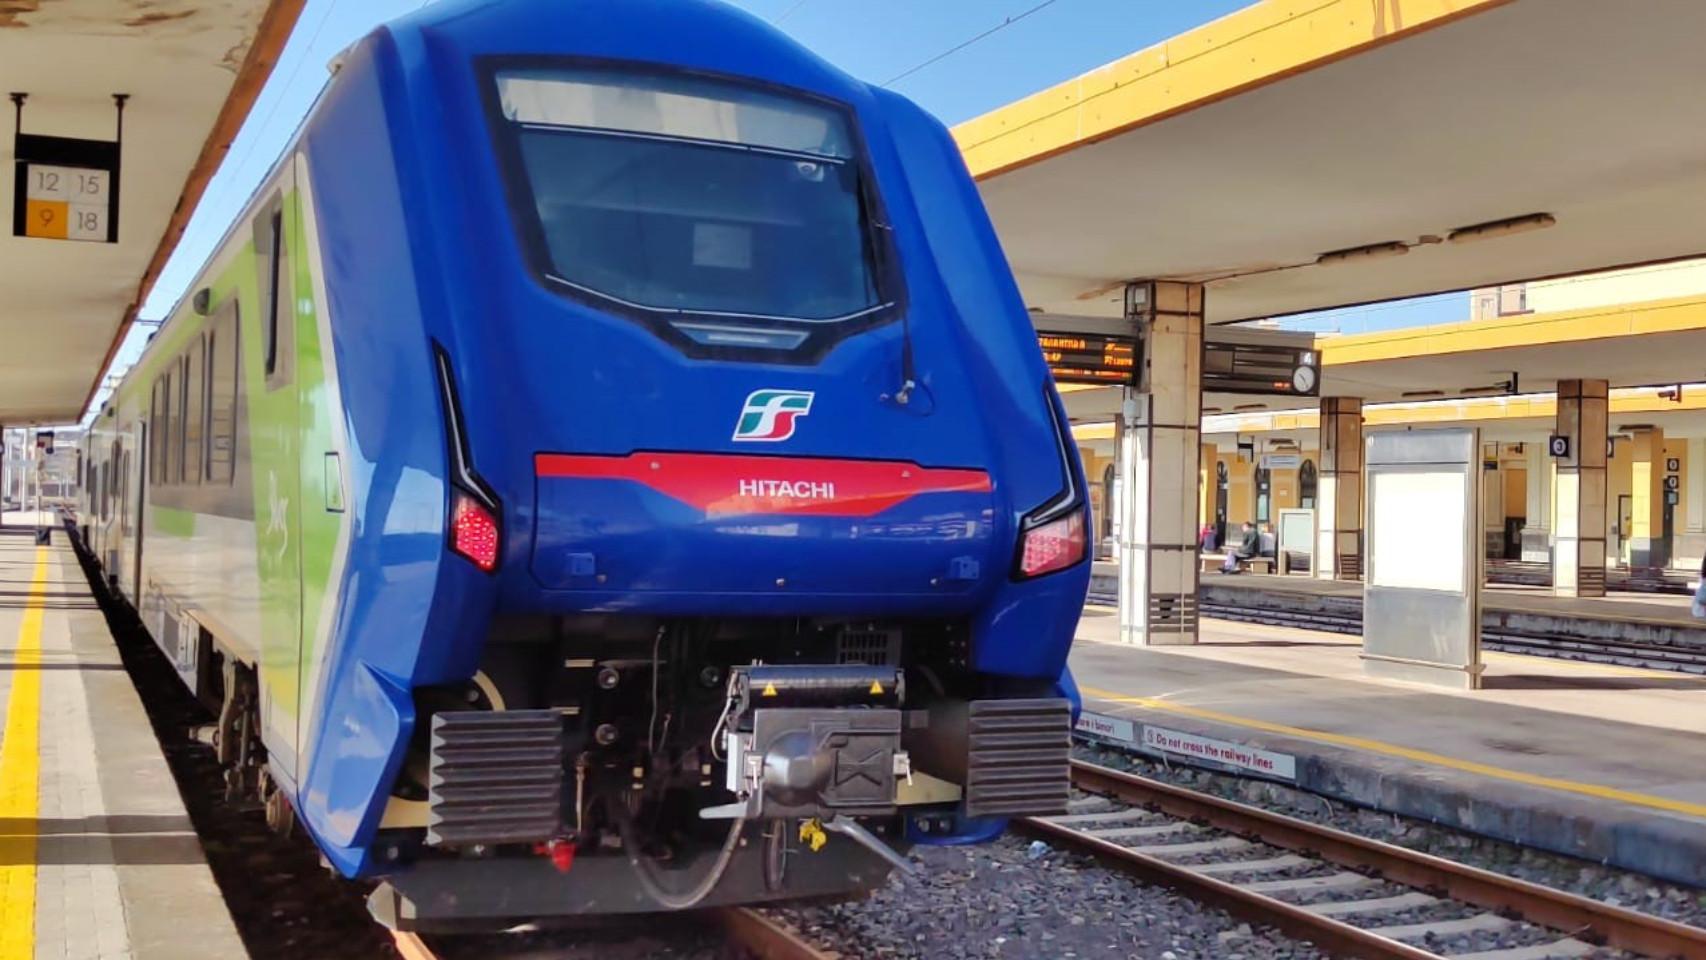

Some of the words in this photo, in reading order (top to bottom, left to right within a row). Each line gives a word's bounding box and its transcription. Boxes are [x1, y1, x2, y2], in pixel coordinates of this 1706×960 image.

[37, 171, 59, 192] 12
[78, 174, 100, 195] 15
[39, 208, 55, 228] 9
[77, 211, 98, 231] 18
[739, 479, 835, 499] HITACHI
[1156, 733, 1167, 745] Do
[1169, 738, 1181, 749] not
[1183, 741, 1203, 753] cross
[1205, 743, 1218, 757] the
[1220, 747, 1251, 765] railway
[1253, 752, 1273, 769] lines
